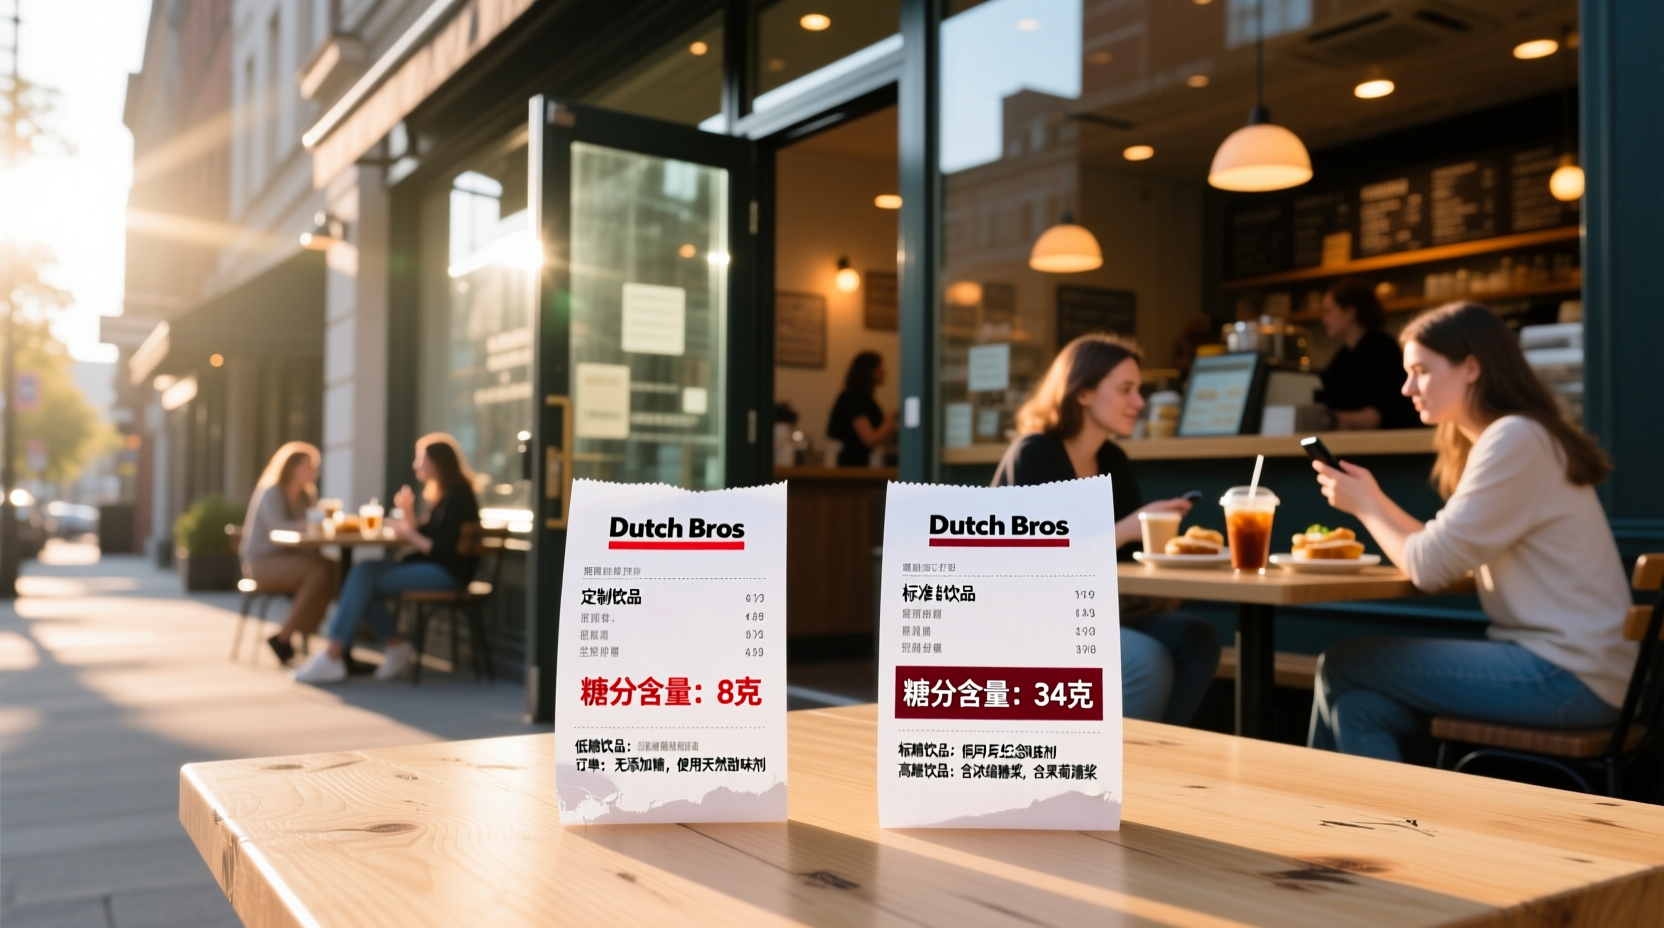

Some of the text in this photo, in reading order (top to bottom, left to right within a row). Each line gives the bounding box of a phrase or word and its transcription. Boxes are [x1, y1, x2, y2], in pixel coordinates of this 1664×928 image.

[609, 516, 745, 538] Dutch Bros
[930, 514, 1070, 536] Dutch Bros
[580, 587, 641, 606] 定制饮品
[580, 676, 762, 707] 糖分含量：8克
[903, 678, 1094, 709] 糖分含量：34克
